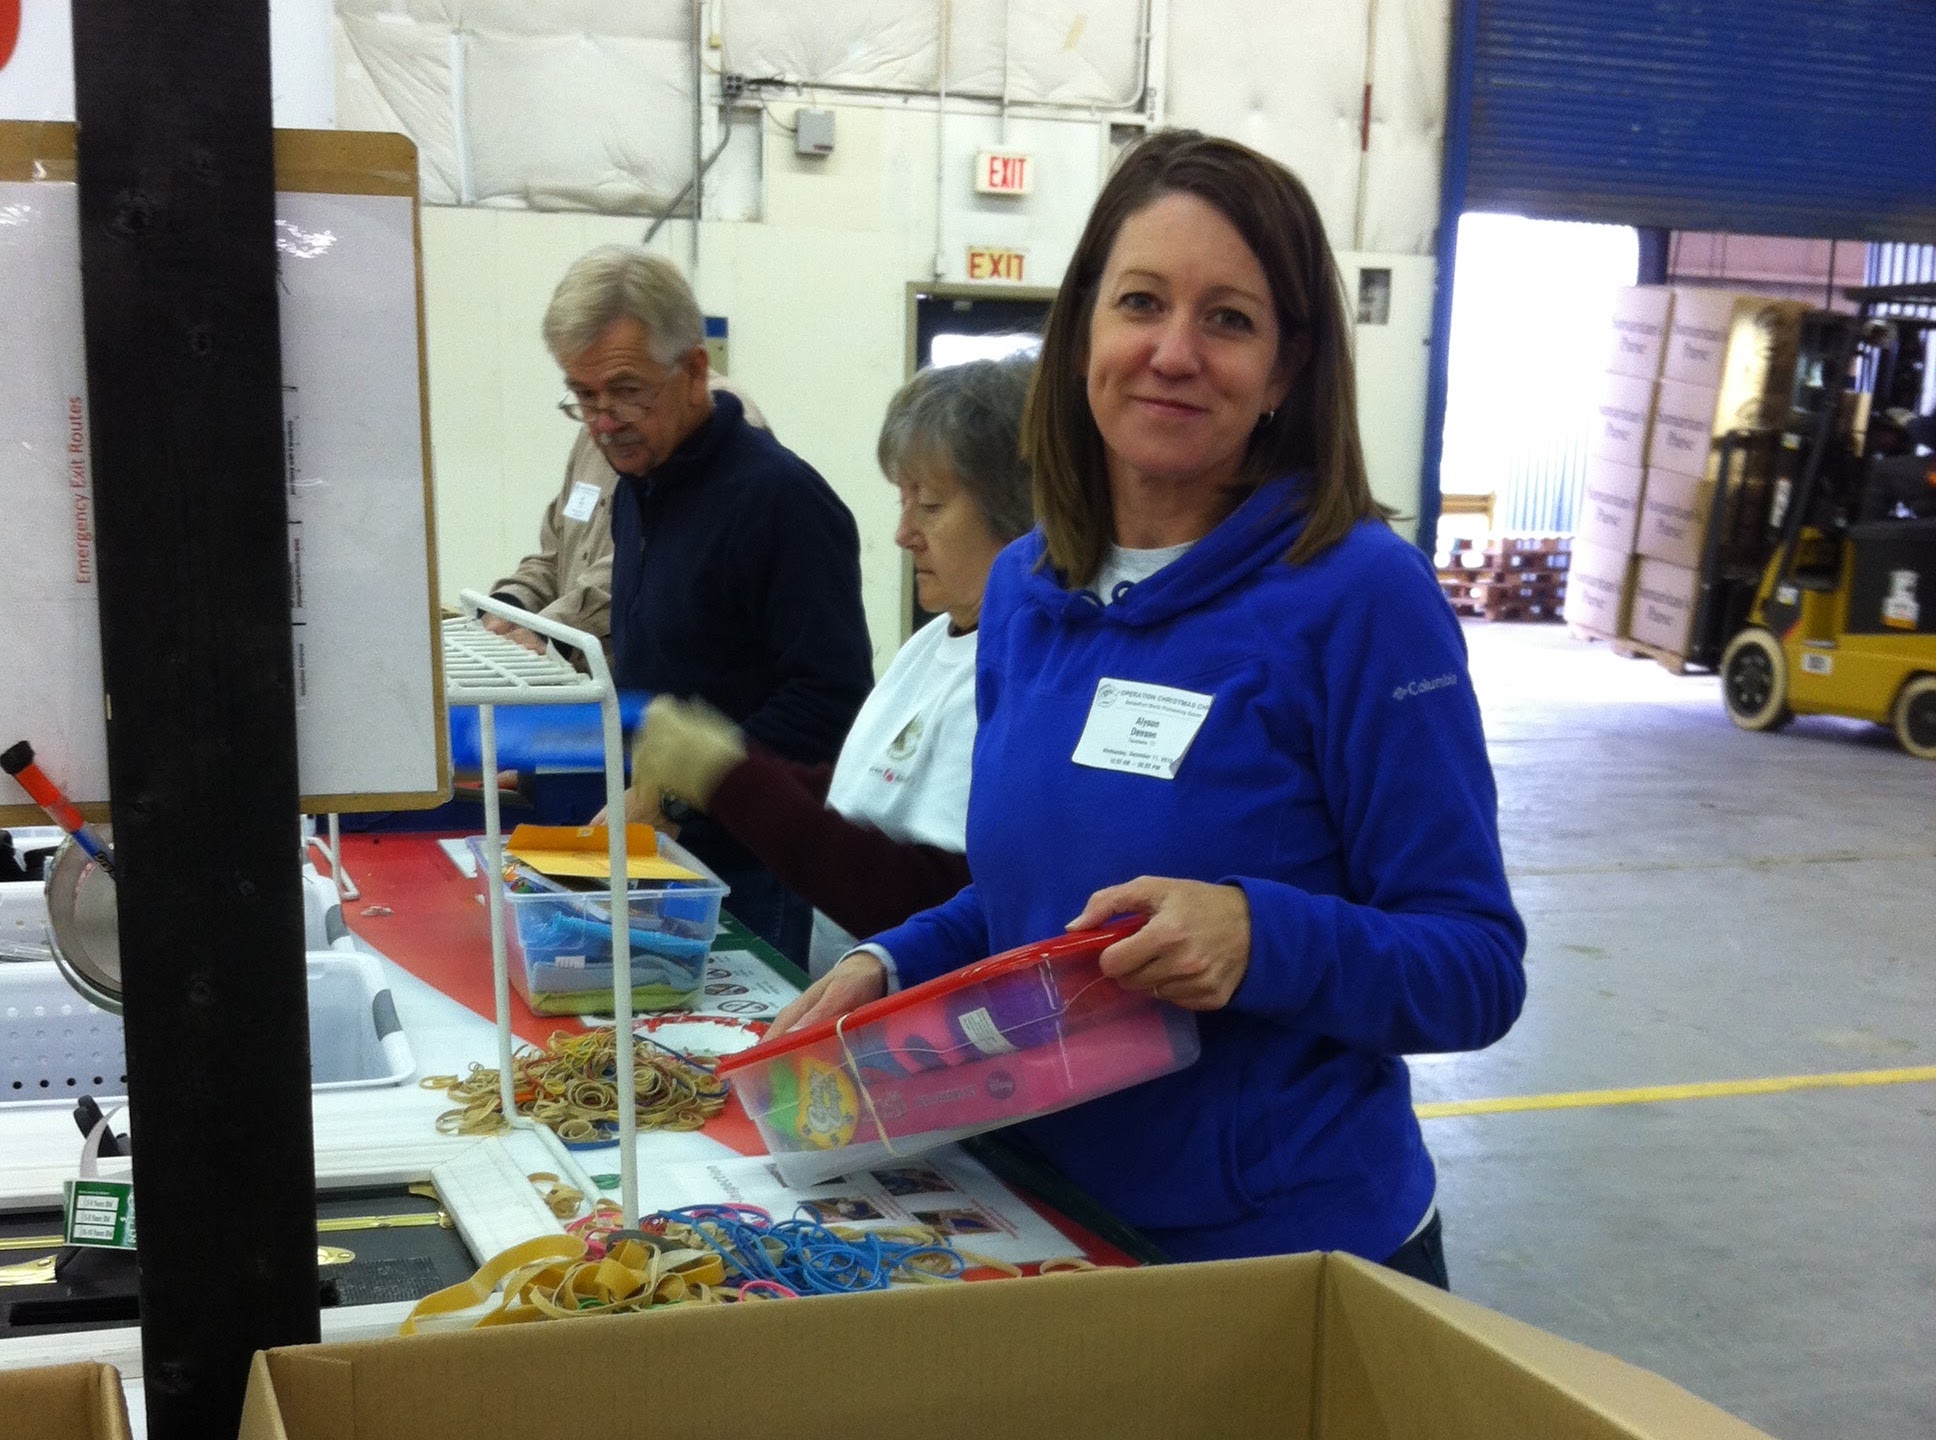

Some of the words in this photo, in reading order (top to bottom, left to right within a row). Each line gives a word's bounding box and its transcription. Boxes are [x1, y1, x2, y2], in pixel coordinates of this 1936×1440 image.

[988, 156, 1027, 189] EXIT
[969, 252, 1025, 282] EXIT
[67, 395, 84, 454] Routes
[69, 460, 86, 489] Exit
[75, 493, 93, 584] Emergency
[1120, 689, 1156, 700] OPERATION
[1157, 695, 1197, 708] CHRISTMAS
